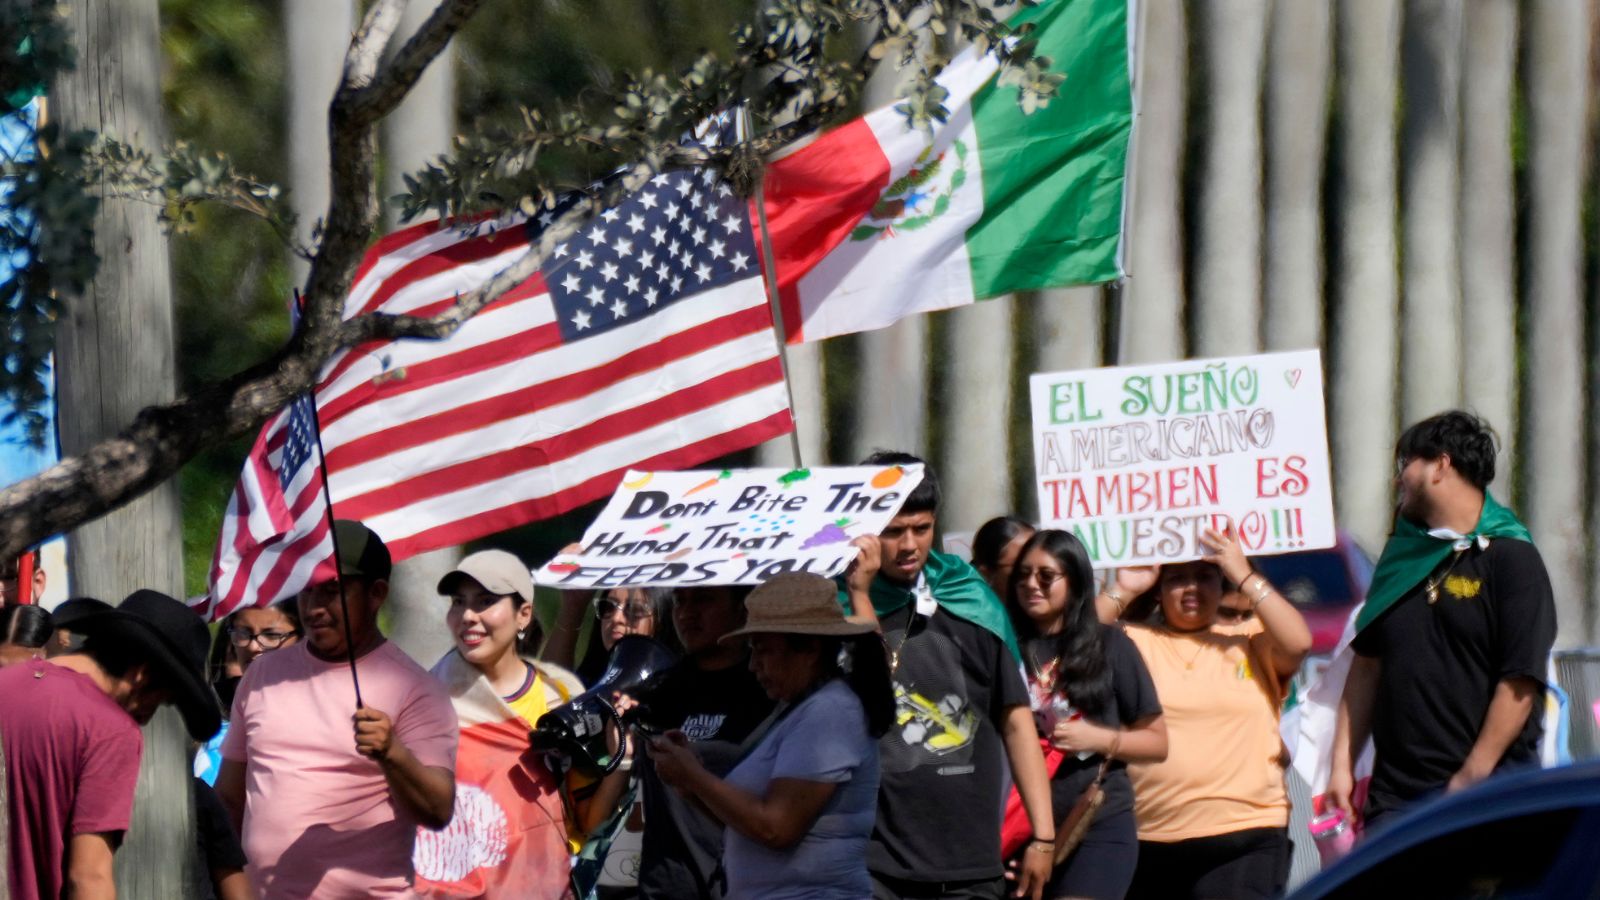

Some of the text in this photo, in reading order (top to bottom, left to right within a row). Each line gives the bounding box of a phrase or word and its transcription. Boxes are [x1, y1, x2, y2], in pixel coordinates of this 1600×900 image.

[1048, 362, 1259, 426] EL SUEÑO
[1040, 408, 1276, 476] AMERICANO
[727, 485, 808, 513] Bite
[824, 482, 900, 513] The
[1043, 455, 1310, 520] TAMBIEN ES
[578, 522, 795, 557] Hand That
[558, 559, 729, 588] FEEDS
